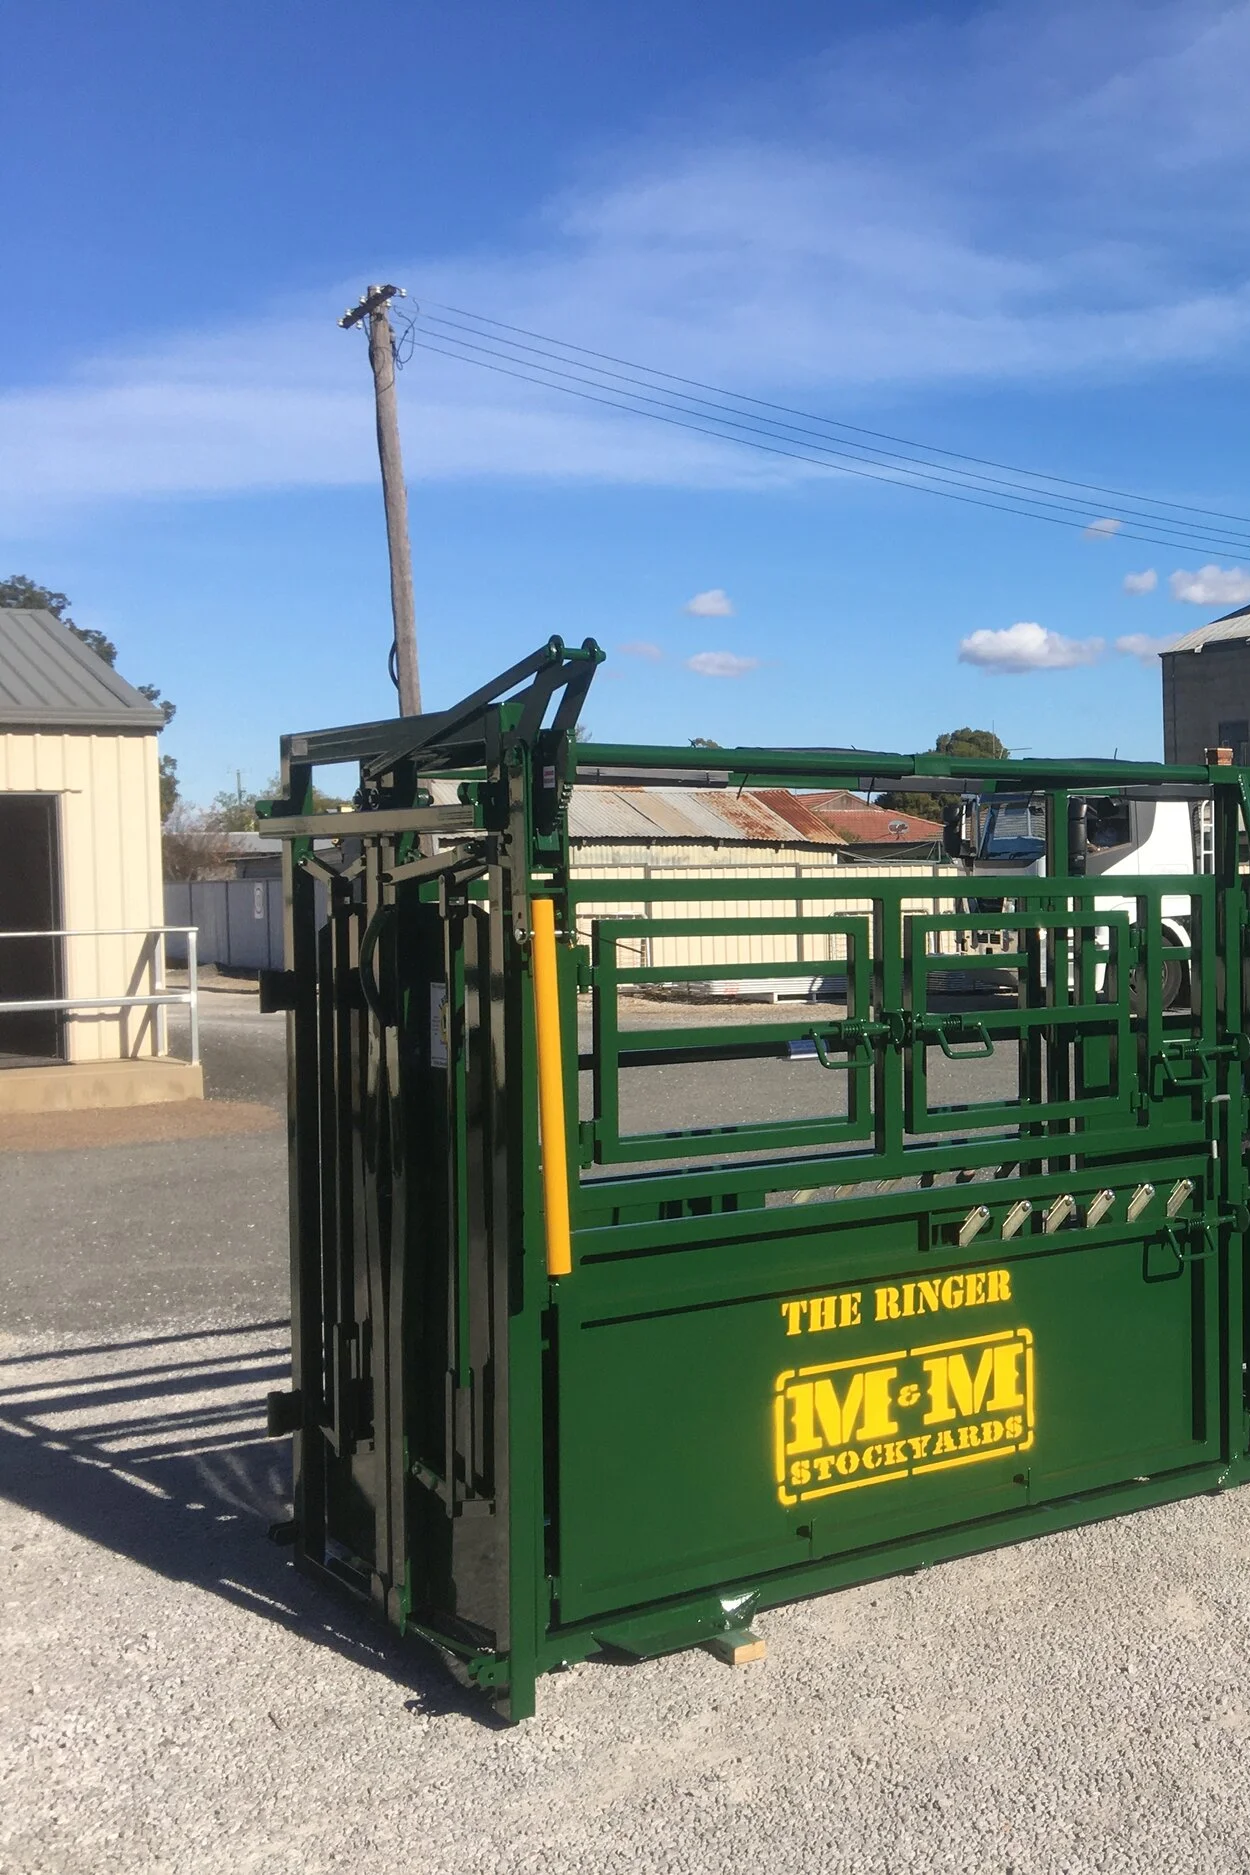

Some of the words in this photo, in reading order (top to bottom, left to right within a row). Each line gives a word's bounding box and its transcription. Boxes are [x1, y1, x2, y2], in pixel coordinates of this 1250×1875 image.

[781, 1292, 862, 1336] THE
[874, 1270, 1012, 1322] RINGER
[790, 1415, 1023, 1485] STOCKYARDS
